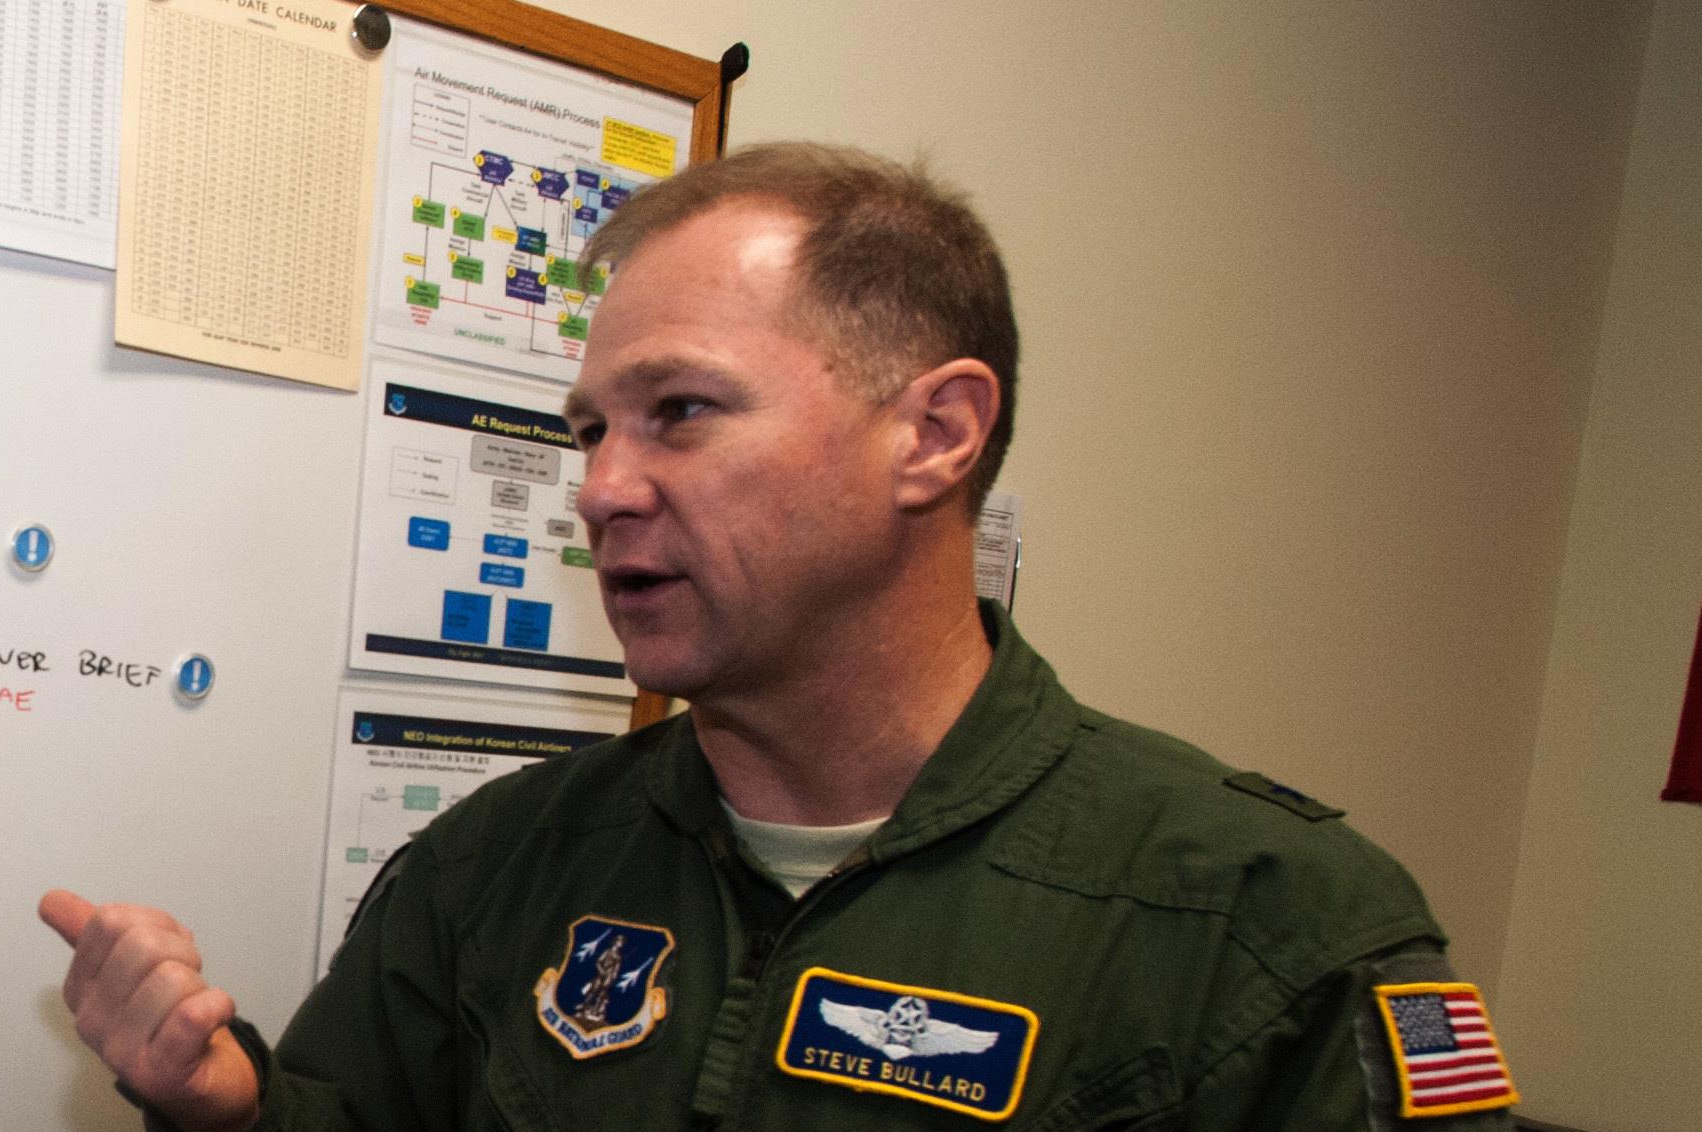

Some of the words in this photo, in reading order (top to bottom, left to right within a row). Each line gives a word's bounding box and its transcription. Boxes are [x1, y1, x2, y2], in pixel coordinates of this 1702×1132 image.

[275, 6, 338, 33] CALENDAR
[414, 66, 429, 79] Air
[431, 70, 485, 96] Movement
[487, 86, 529, 109] Request
[563, 107, 601, 129] Process
[472, 414, 488, 428] AE
[489, 416, 532, 436] Request
[532, 426, 572, 444] Process
[79, 650, 163, 687] BRIEF
[403, 730, 426, 742] NEO
[426, 732, 474, 747] Integration
[475, 736, 485, 746] of
[485, 737, 517, 750] Korean
[518, 739, 538, 751] Civil
[803, 1045, 874, 1081] STEVE
[878, 1060, 987, 1104] BULLARD
